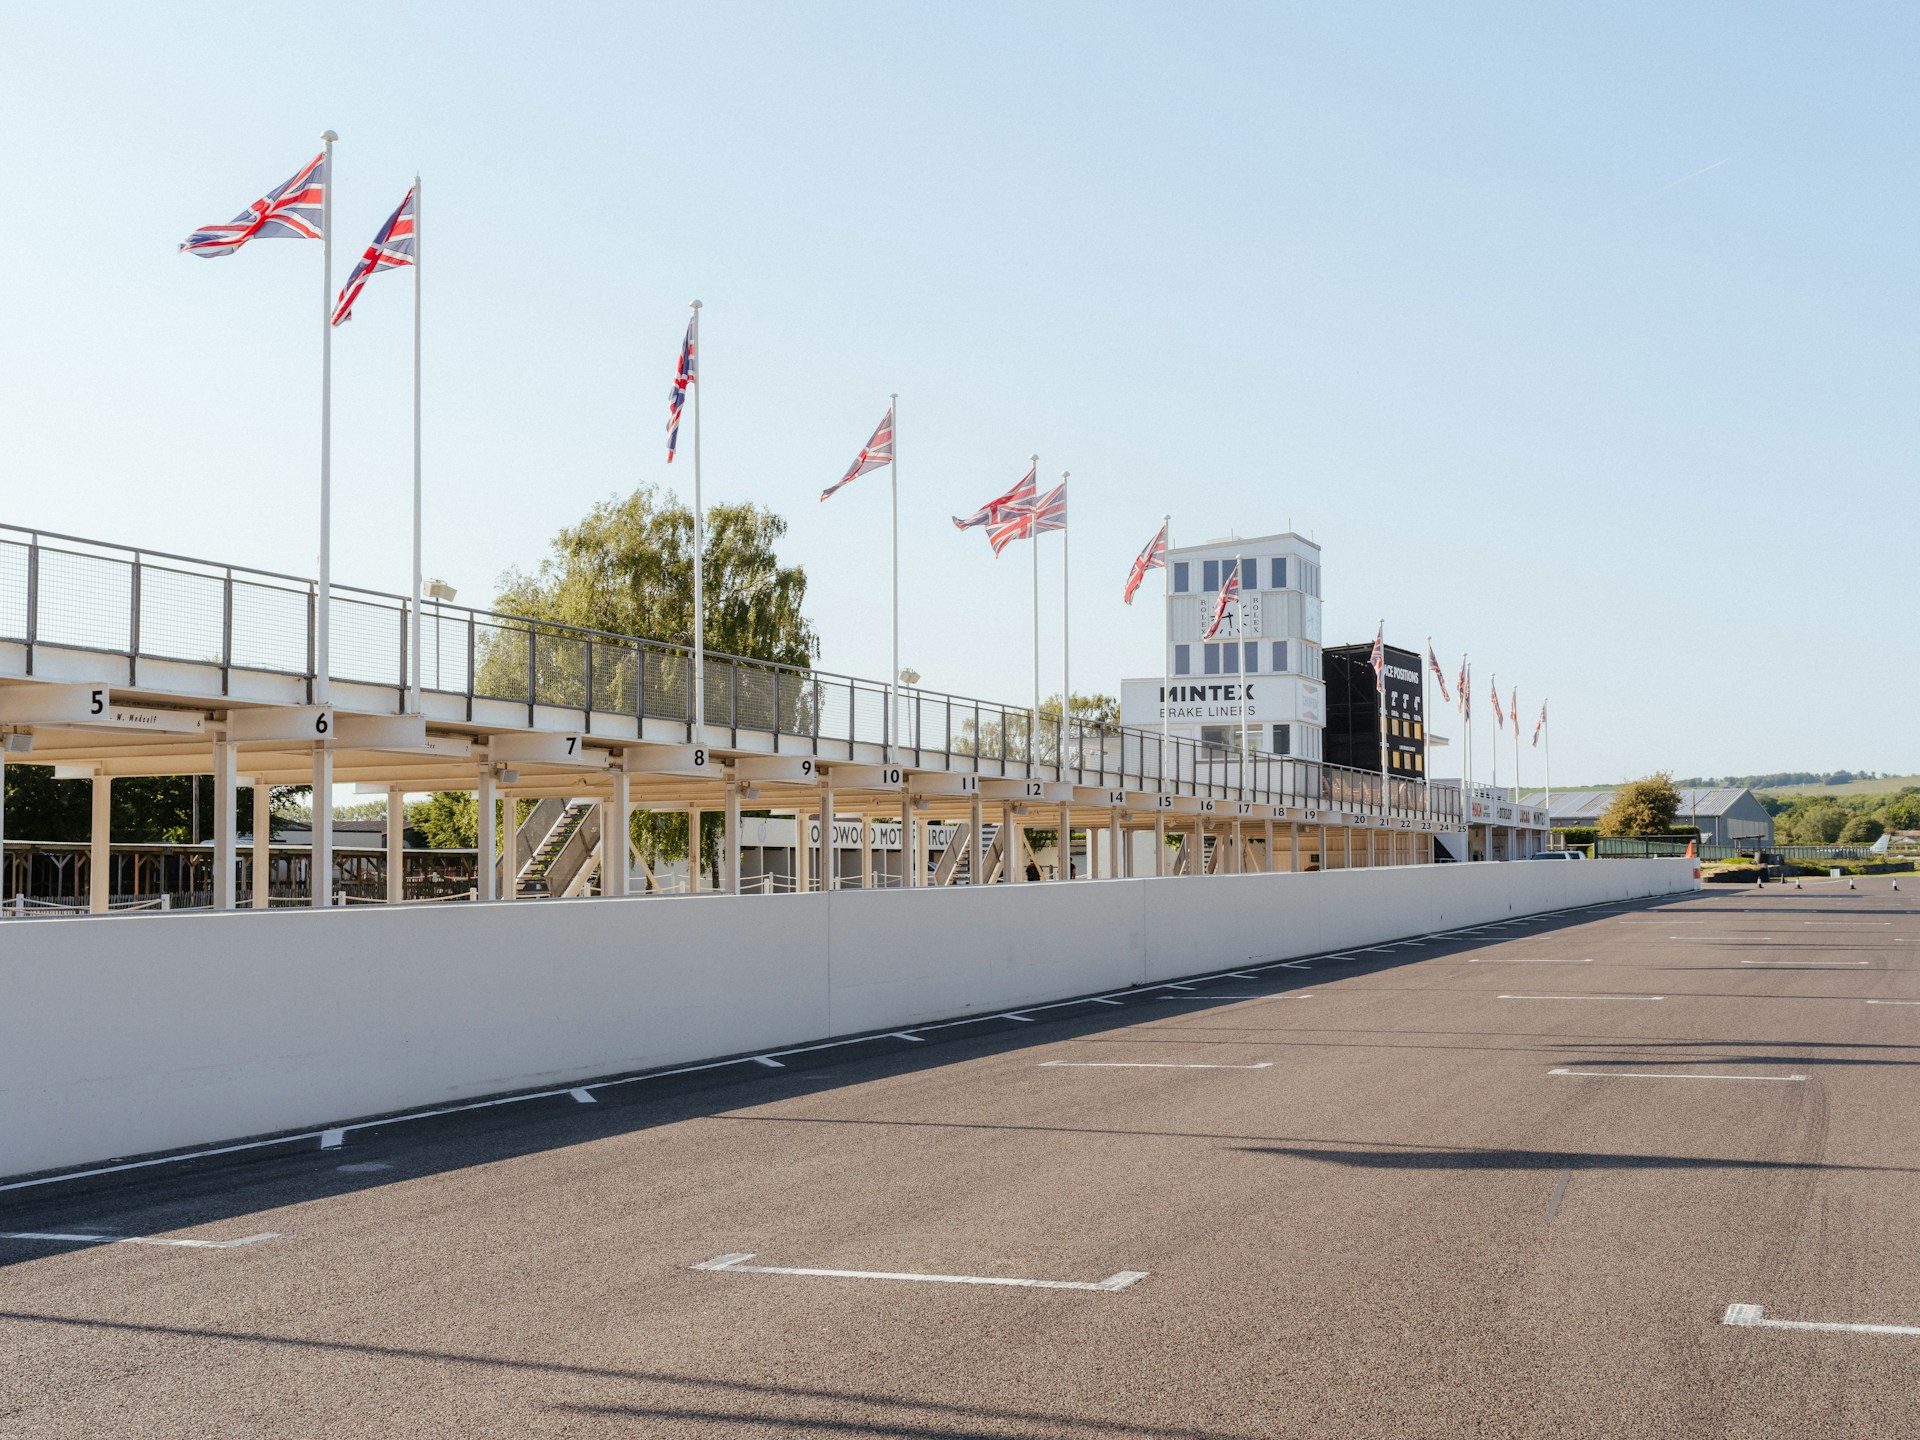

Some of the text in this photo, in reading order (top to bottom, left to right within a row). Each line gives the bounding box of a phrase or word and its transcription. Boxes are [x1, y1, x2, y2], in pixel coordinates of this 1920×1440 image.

[1384, 664, 1419, 685] ACE POSITIONS
[1160, 684, 1254, 702] MINTEX
[91, 690, 103, 714] 5
[315, 712, 328, 733] 6
[566, 737, 577, 755] 7
[694, 750, 705, 766] 8
[802, 760, 811, 775] 9
[883, 769, 899, 783] 10
[962, 777, 976, 790] 11
[1026, 783, 1041, 796] 12
[1110, 792, 1123, 802] 14
[1159, 796, 1171, 807] 15
[1201, 801, 1213, 811] 16
[1239, 804, 1250, 813] 17
[1273, 807, 1285, 817] 18
[1304, 811, 1316, 819] 19
[1354, 815, 1366, 824] 20
[1380, 818, 1389, 826] 21
[1400, 820, 1411, 828] 22
[1421, 822, 1431, 830] 23
